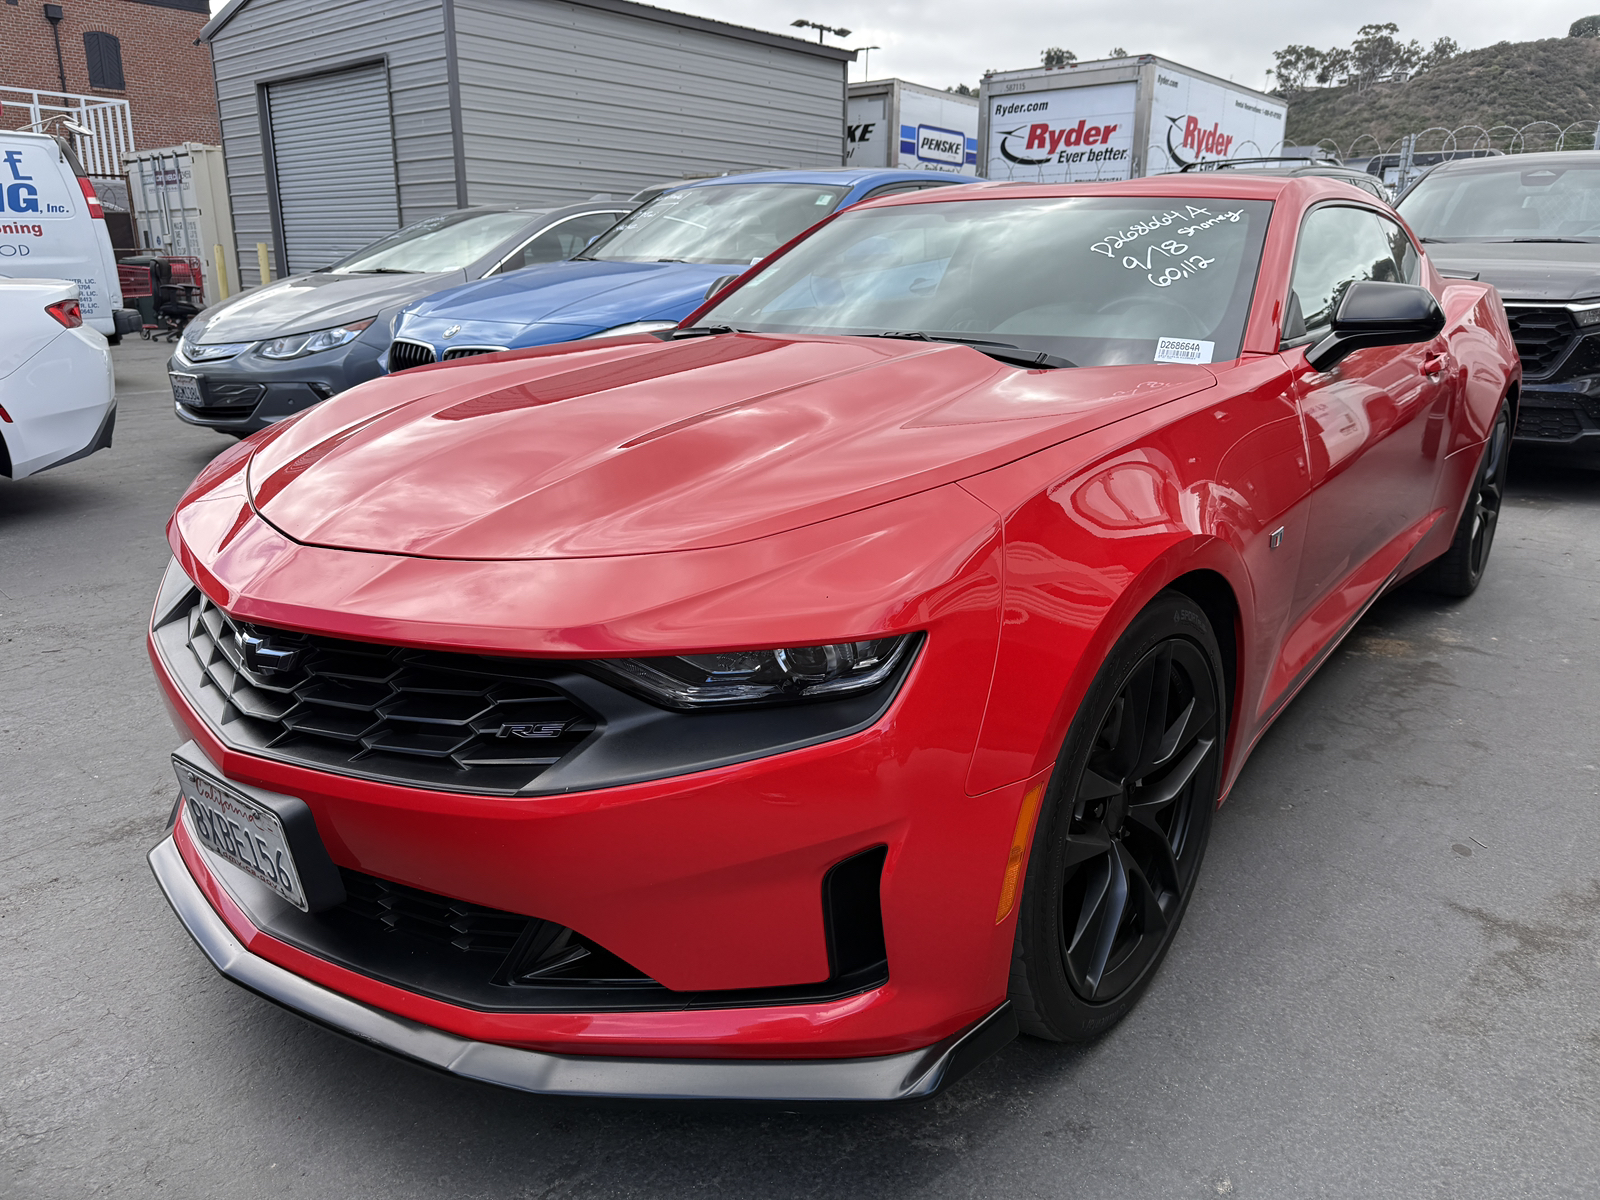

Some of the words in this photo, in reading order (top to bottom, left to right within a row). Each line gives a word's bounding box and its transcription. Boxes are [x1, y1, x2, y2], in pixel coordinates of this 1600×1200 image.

[995, 101, 1049, 117] Ryder.com
[846, 122, 876, 143] KE
[1025, 119, 1118, 155] Ryder
[1182, 115, 1233, 160] Ryder
[920, 136, 962, 156] PENSKE
[1057, 150, 1088, 164] Ever
[1086, 147, 1128, 163] better.
[46, 203, 70, 213] Inc.
[0, 221, 43, 237] ning
[1160, 340, 1201, 351] D268664A
[496, 722, 562, 739] RS
[196, 777, 264, 832] California
[189, 797, 293, 893] 8XBE156
[222, 851, 278, 890] dmv.ca.gov
